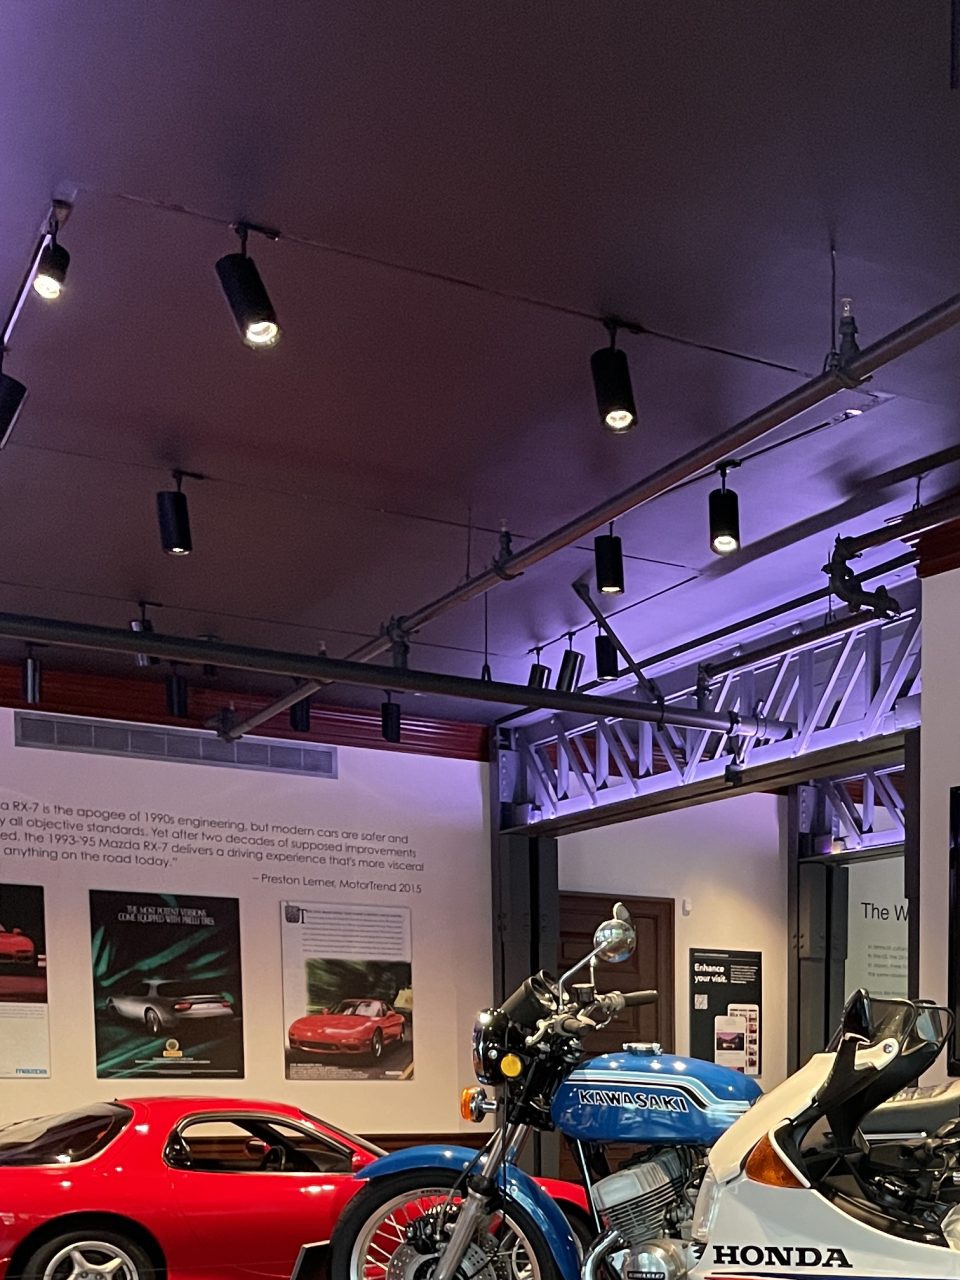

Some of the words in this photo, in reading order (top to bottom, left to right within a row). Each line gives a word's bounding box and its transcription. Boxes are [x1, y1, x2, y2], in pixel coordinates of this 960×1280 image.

[13, 801, 39, 813] RX-7
[42, 804, 50, 815] is
[54, 805, 74, 816] the
[76, 808, 126, 821] apogee
[129, 811, 141, 822] of
[145, 813, 175, 825] 1990s
[178, 816, 248, 833] engineering,
[250, 822, 269, 833] but
[272, 825, 315, 837] modern
[317, 828, 339, 839] cars
[341, 830, 359, 840] are
[361, 831, 386, 843] safer
[388, 833, 409, 844] and
[9, 816, 23, 826] all
[26, 817, 84, 832] objective
[87, 822, 149, 837] standards.
[152, 828, 169, 838] Yet
[172, 829, 199, 841] after
[201, 831, 223, 843] two
[225, 834, 275, 847] decades
[278, 837, 289, 848] of
[291, 840, 343, 853] supposed
[345, 843, 417, 858] improvements
[4, 847, 58, 861] anything
[61, 851, 77, 861] on
[80, 851, 100, 862] the
[103, 853, 132, 865] road
[24, 832, 44, 843] the
[99, 838, 140, 850] Mazda
[143, 842, 168, 852] RX-7
[171, 843, 214, 856] delivers
[216, 848, 224, 857] a
[227, 847, 263, 861] driving
[266, 851, 327, 865] experience
[329, 855, 356, 867] that's
[358, 859, 385, 869] more
[387, 859, 425, 872] visceral
[261, 874, 300, 885] Preston
[303, 877, 337, 888] Lerner,
[339, 880, 397, 892] MotorTrend
[399, 883, 422, 894] 2015
[861, 902, 890, 920] The
[694, 963, 725, 973] Enhance
[694, 975, 711, 984] your
[711, 974, 728, 983] visit.
[578, 1089, 689, 1112] KAWASAKI
[713, 1245, 853, 1268] HONDA
